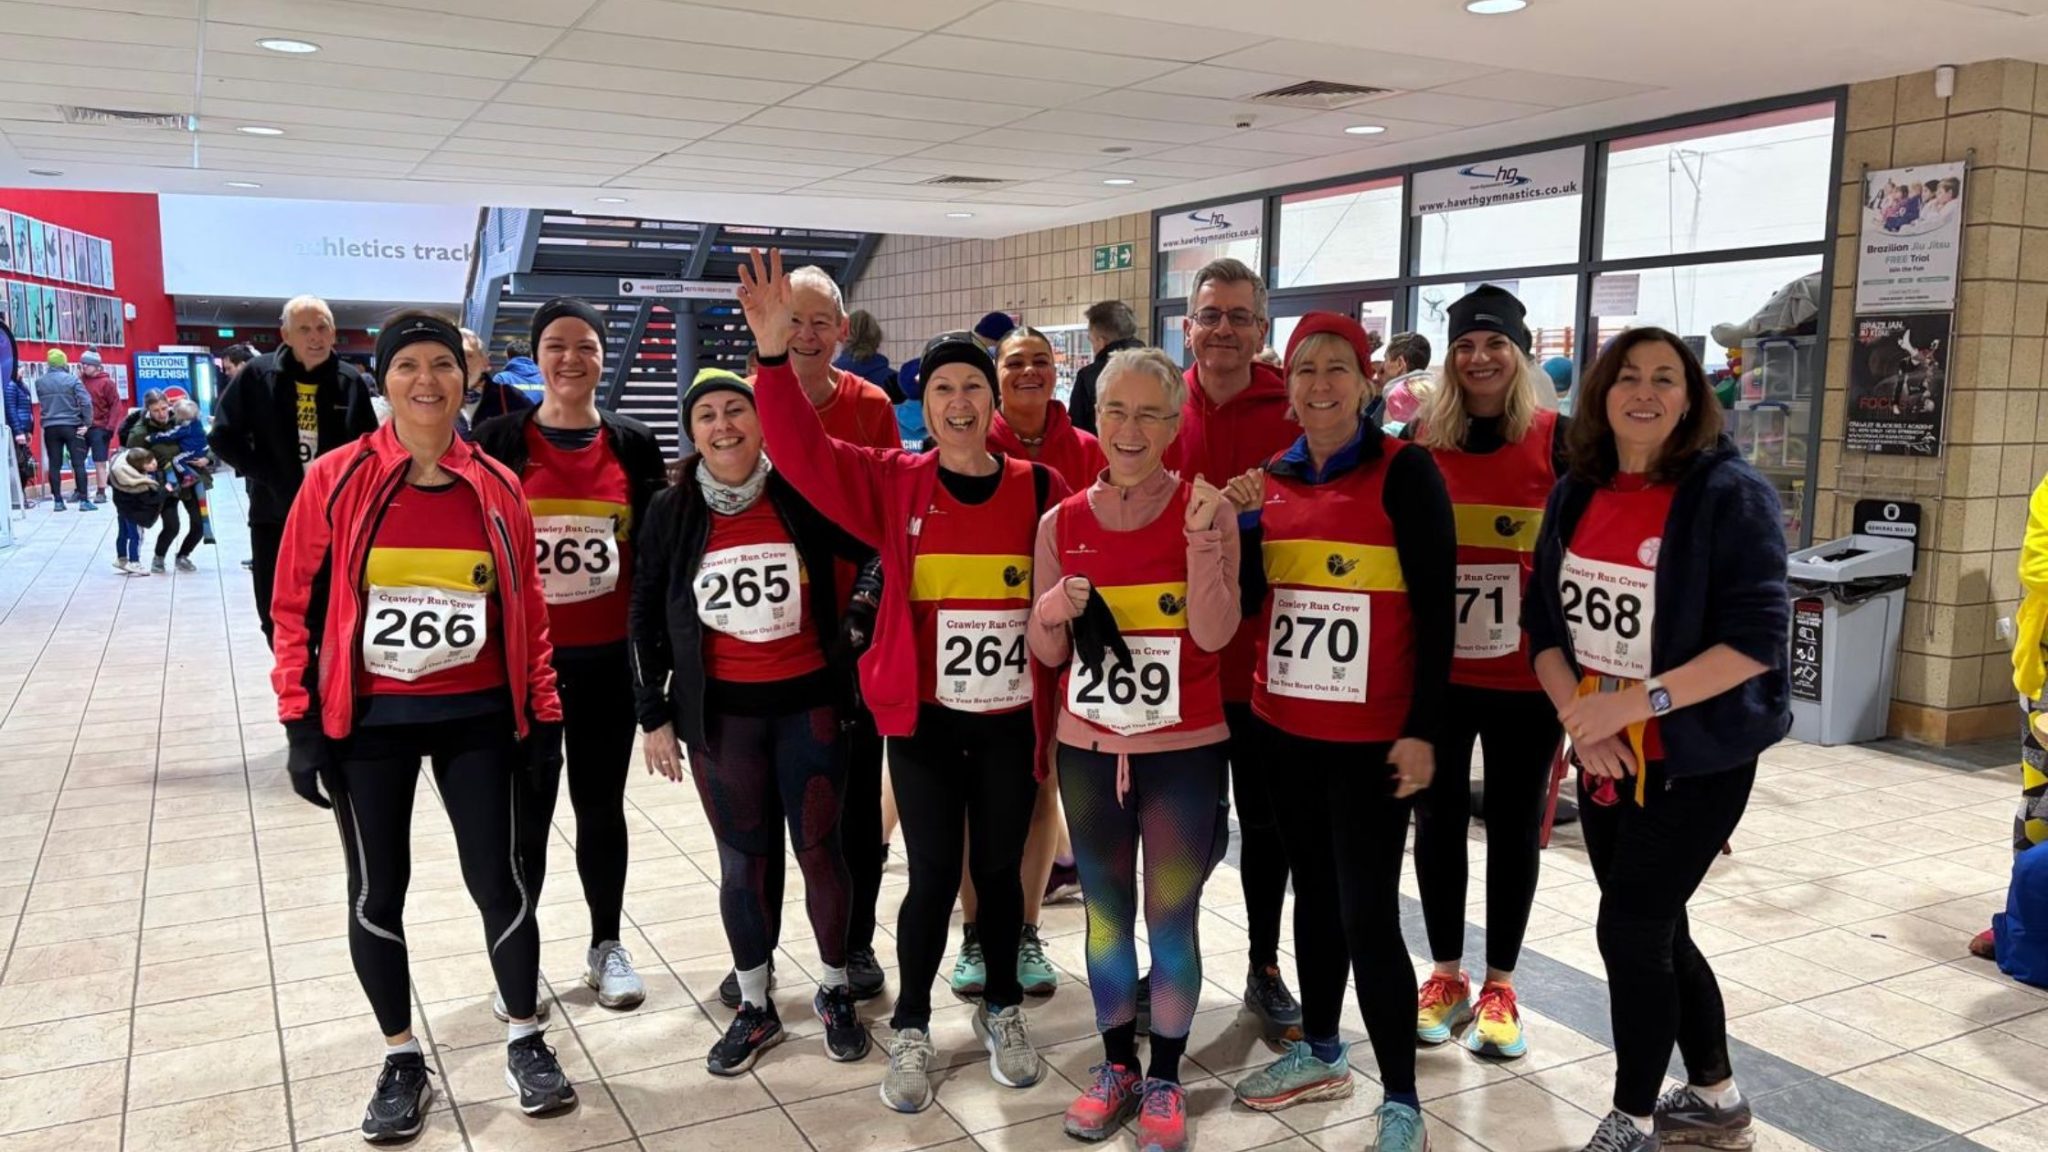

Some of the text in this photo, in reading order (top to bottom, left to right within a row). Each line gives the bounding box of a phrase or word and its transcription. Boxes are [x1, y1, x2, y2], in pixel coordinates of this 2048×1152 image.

[1419, 181, 1577, 212] www.hawthgymnastics.co.uk
[1867, 244, 1909, 254] Brazilian
[1910, 254, 1930, 263] Trial
[140, 356, 185, 367] EVERYONE
[139, 369, 189, 379] REPLENISH
[534, 525, 606, 534] rawley Run Crew
[536, 538, 610, 575] 263
[700, 551, 787, 569] Crawley Run Crew
[1464, 573, 1483, 581] Run
[1485, 573, 1510, 581] Crew
[1597, 572, 1616, 583] Run
[1619, 576, 1648, 589] Crew
[701, 564, 790, 611] 265
[379, 593, 476, 609] Crawley Run Crew
[1278, 599, 1360, 613] Cwley Run Crew
[1561, 580, 1641, 639] 268
[372, 608, 476, 649] 266
[946, 619, 987, 631] Crawley
[988, 620, 1007, 629] Run
[1273, 614, 1359, 663] 270
[944, 634, 1028, 677] 264
[1130, 647, 1171, 656] un Crew
[1076, 662, 1171, 706] 269
